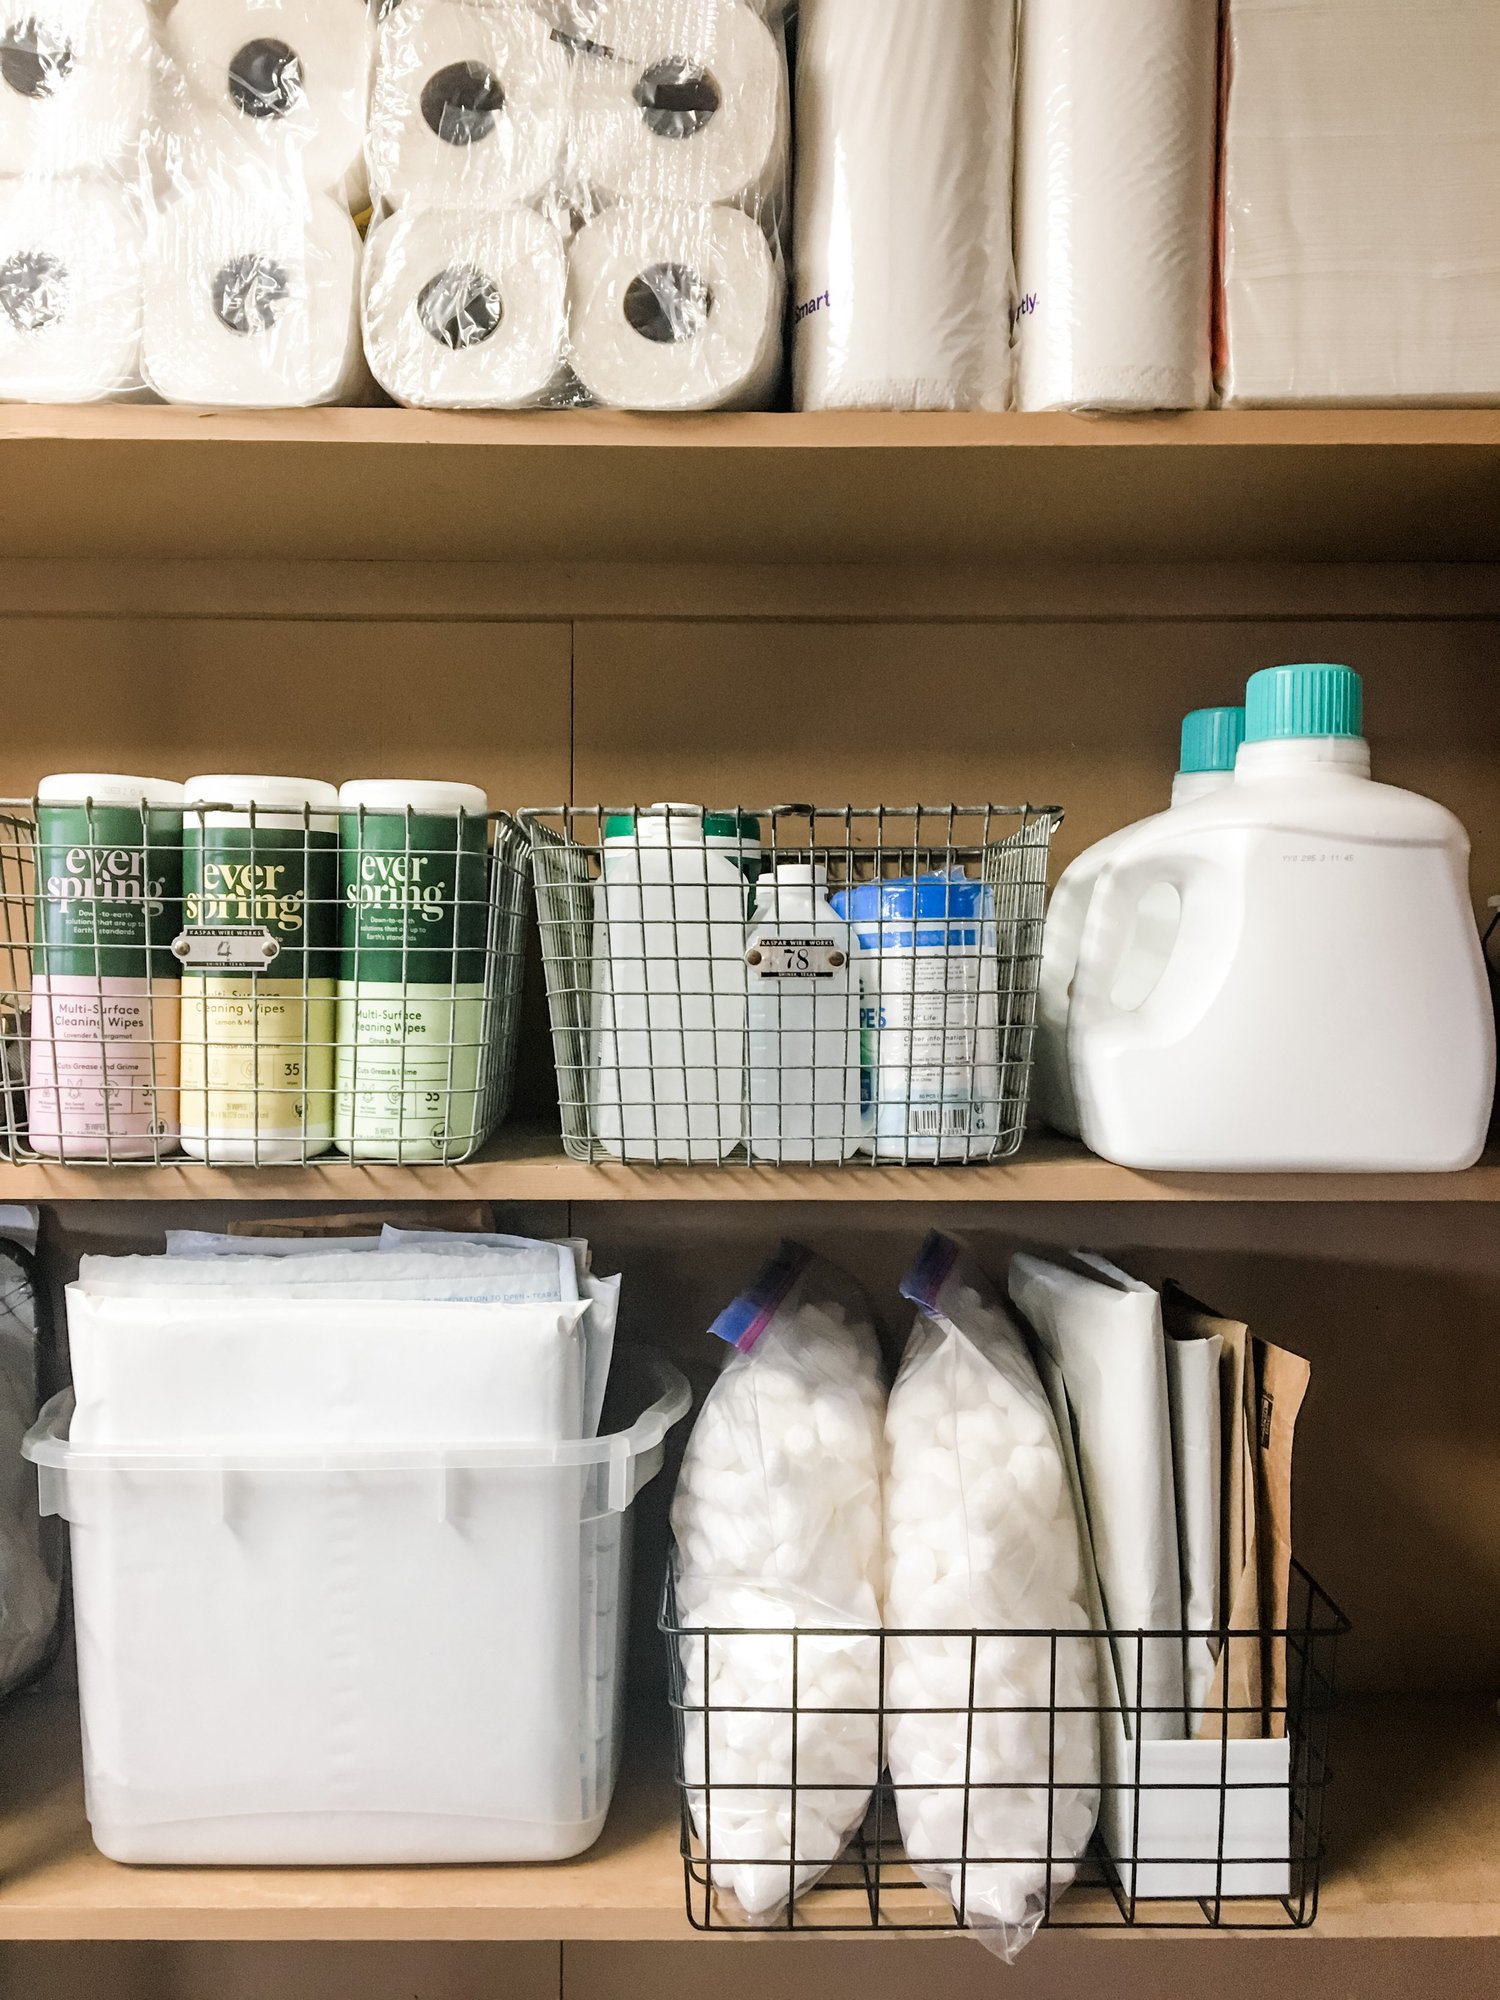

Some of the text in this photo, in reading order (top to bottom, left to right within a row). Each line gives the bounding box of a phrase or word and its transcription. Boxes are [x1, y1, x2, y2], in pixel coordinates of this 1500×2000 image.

[65, 848, 146, 876] ever
[361, 855, 429, 882] ever
[203, 863, 286, 890] ever
[46, 870, 167, 917] spring
[346, 876, 446, 922] spring
[78, 909, 133, 919] Dow-to-earth
[186, 885, 305, 932] spring
[127, 921, 137, 929] up
[370, 916, 415, 925] Down-to-eath
[73, 926, 97, 935] Earth'
[783, 948, 809, 970] 78
[58, 1003, 140, 1015] Multi-Surface
[196, 1002, 244, 1016] Ceaning
[108, 1017, 145, 1030] Wipes
[394, 1023, 427, 1034] Wpes
[101, 1033, 133, 1041] ergamot
[116, 1063, 139, 1071] Grime
[284, 1063, 300, 1076] 35
[397, 1068, 418, 1076] Gime
[141, 1084, 155, 1097] 3
[434, 1294, 488, 1302] FORATION
[503, 1293, 525, 1301] OPEN
